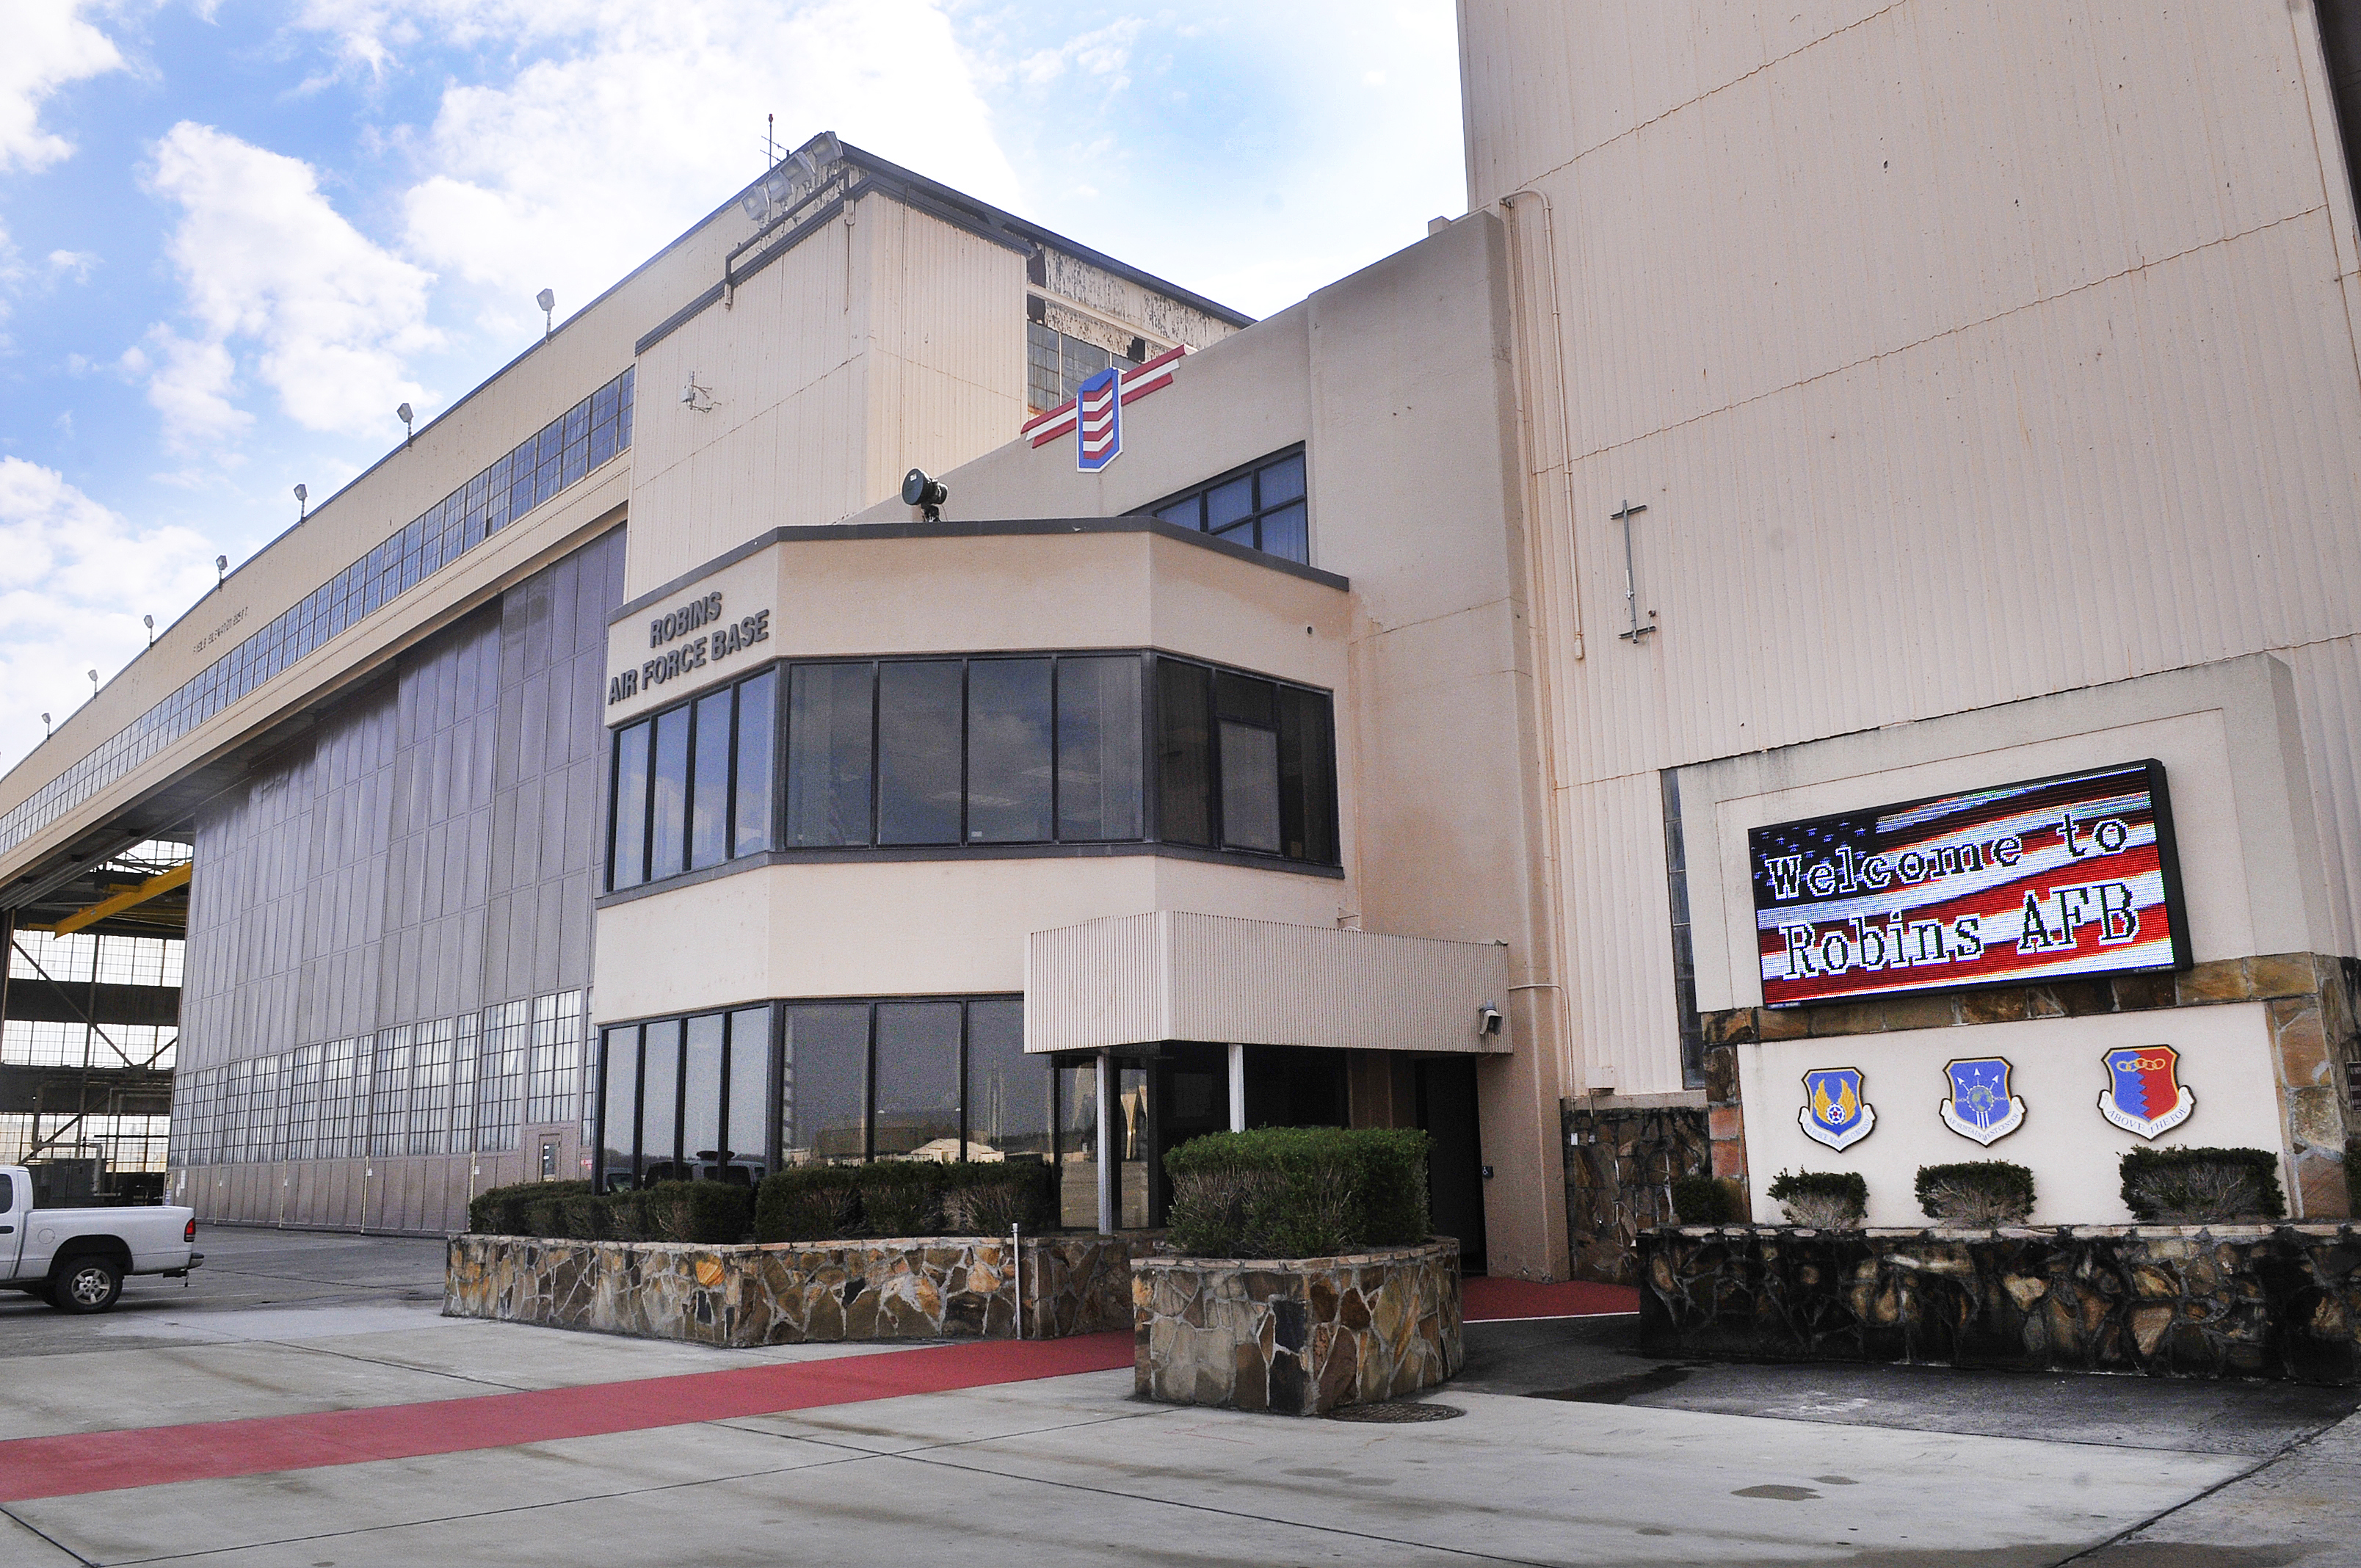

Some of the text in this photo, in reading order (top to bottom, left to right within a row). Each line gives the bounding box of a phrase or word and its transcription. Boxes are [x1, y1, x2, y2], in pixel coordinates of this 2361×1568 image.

[608, 609, 769, 705] AIR FORCE BASE
[650, 590, 722, 648] ROBINS
[1764, 813, 2129, 900] Welcome to
[1780, 883, 2140, 980] Robins AFB
[2107, 1106, 2188, 1133] ABOVE THE FOE
